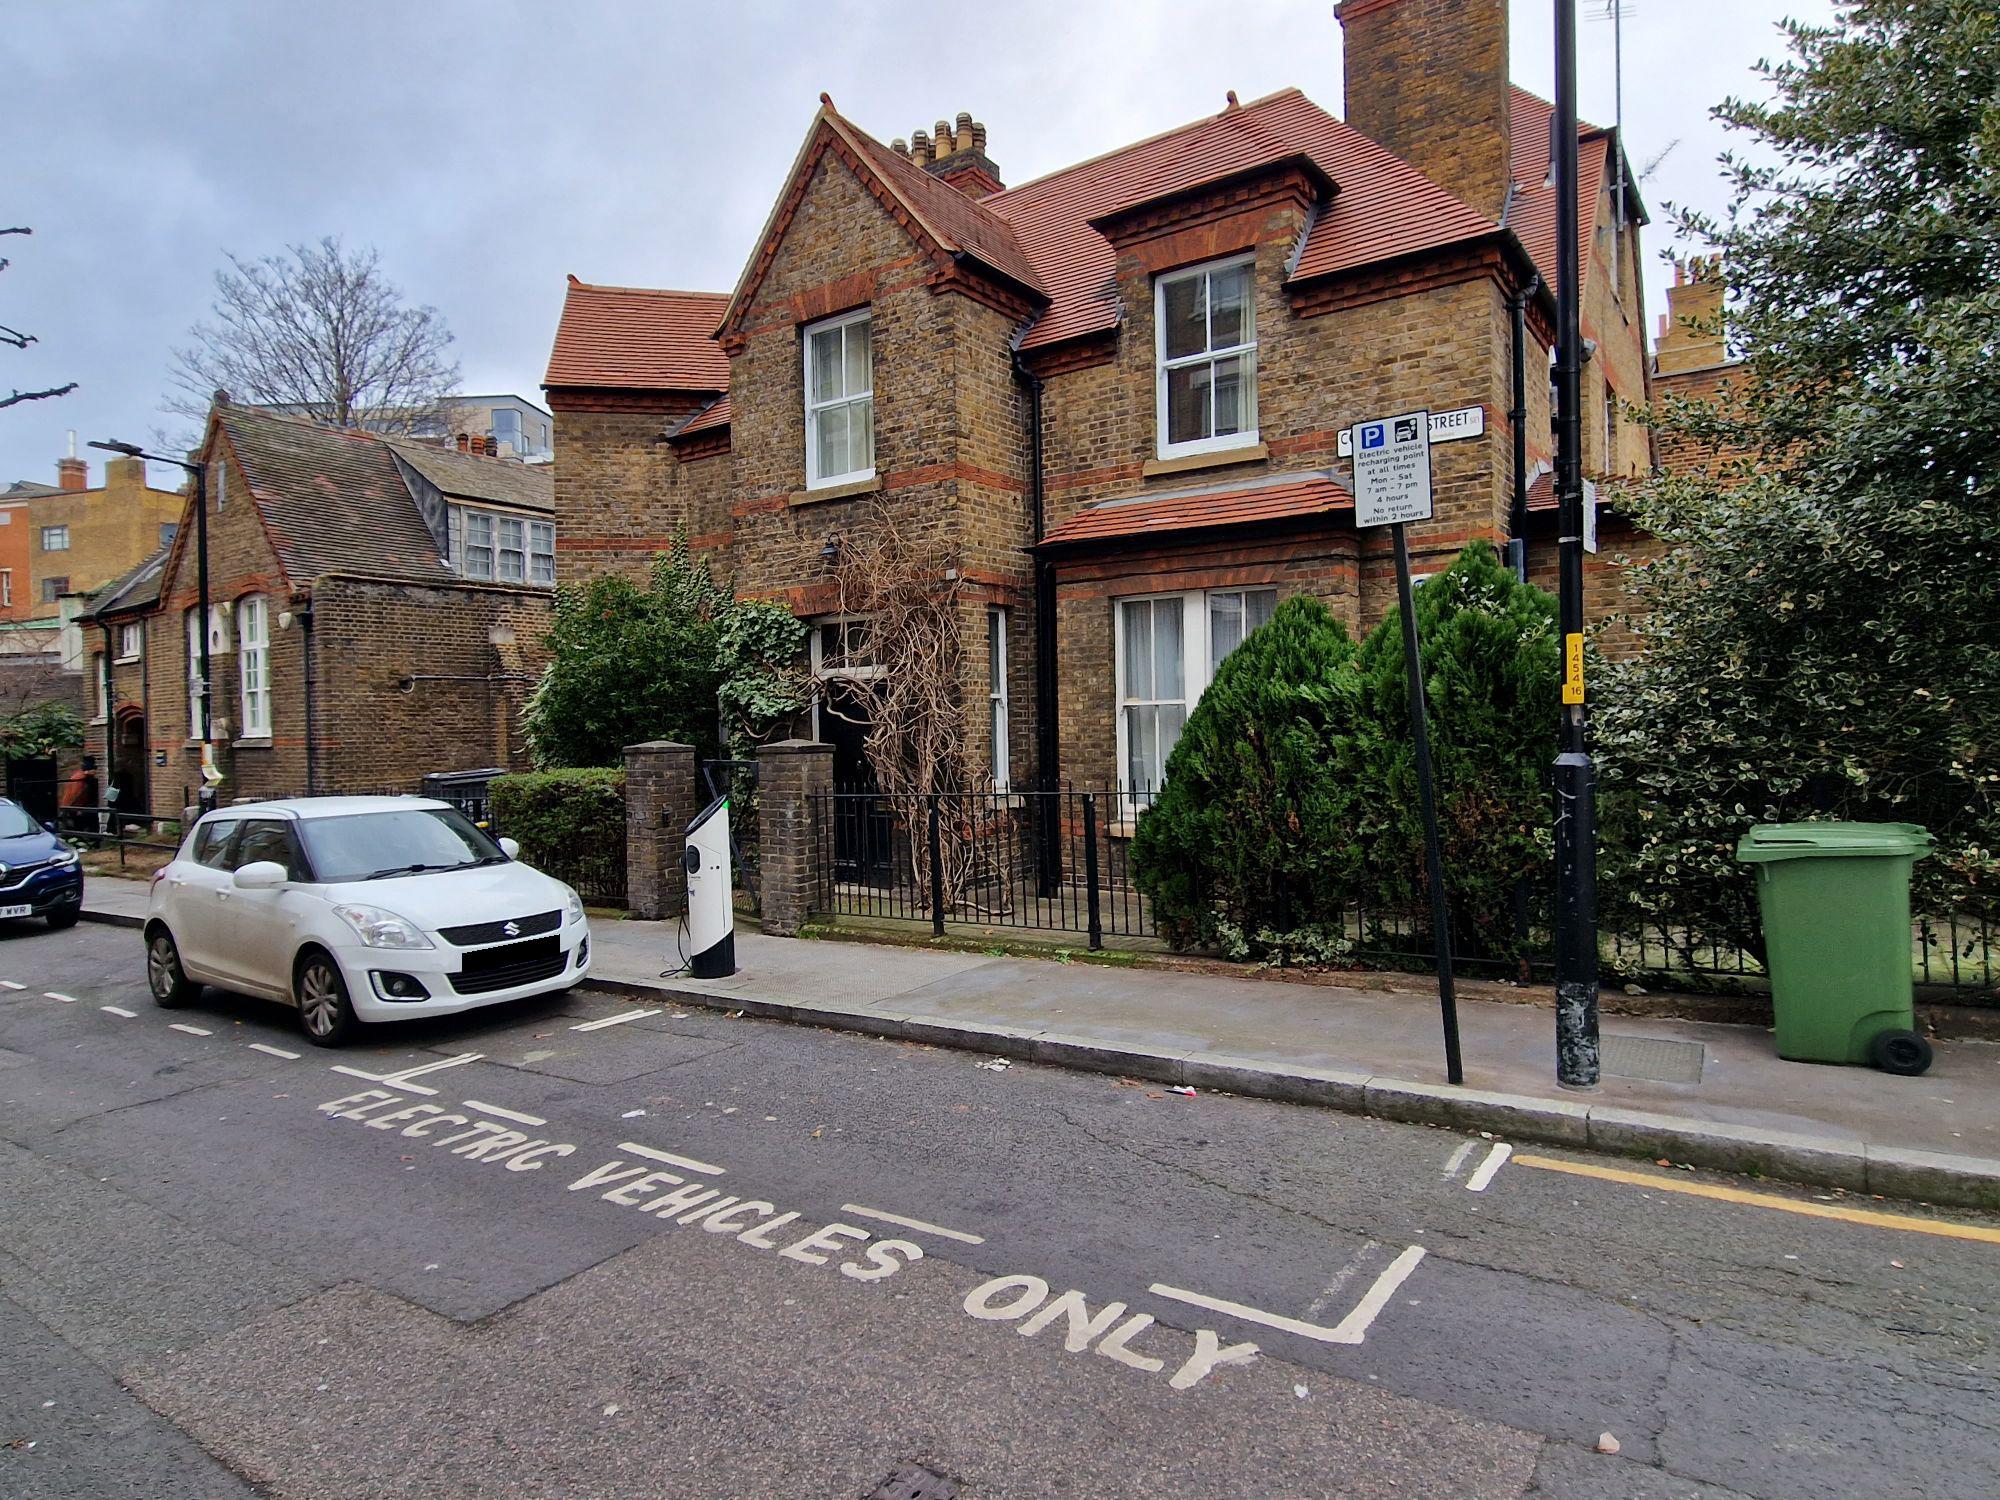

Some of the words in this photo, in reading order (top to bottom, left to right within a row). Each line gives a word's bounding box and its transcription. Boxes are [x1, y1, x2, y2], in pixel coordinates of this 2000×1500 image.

[1365, 427, 1380, 447] P
[1359, 449, 1390, 459] Electric
[1394, 443, 1422, 453] vehicle
[1358, 456, 1400, 467] recharging
[1404, 451, 1424, 460] point
[1380, 465, 1389, 473] all
[1393, 462, 1416, 471] times
[1398, 472, 1412, 480] Sat
[1405, 481, 1418, 489] pm
[1386, 493, 1409, 501] hours
[1388, 504, 1413, 512] return
[1364, 515, 1388, 524] within
[1401, 510, 1423, 519] hours
[1571, 686, 1582, 695] 16
[317, 1089, 577, 1171] ELECTRIC
[567, 1160, 924, 1284] VEHICLES
[963, 1274, 1261, 1390] ONLY
